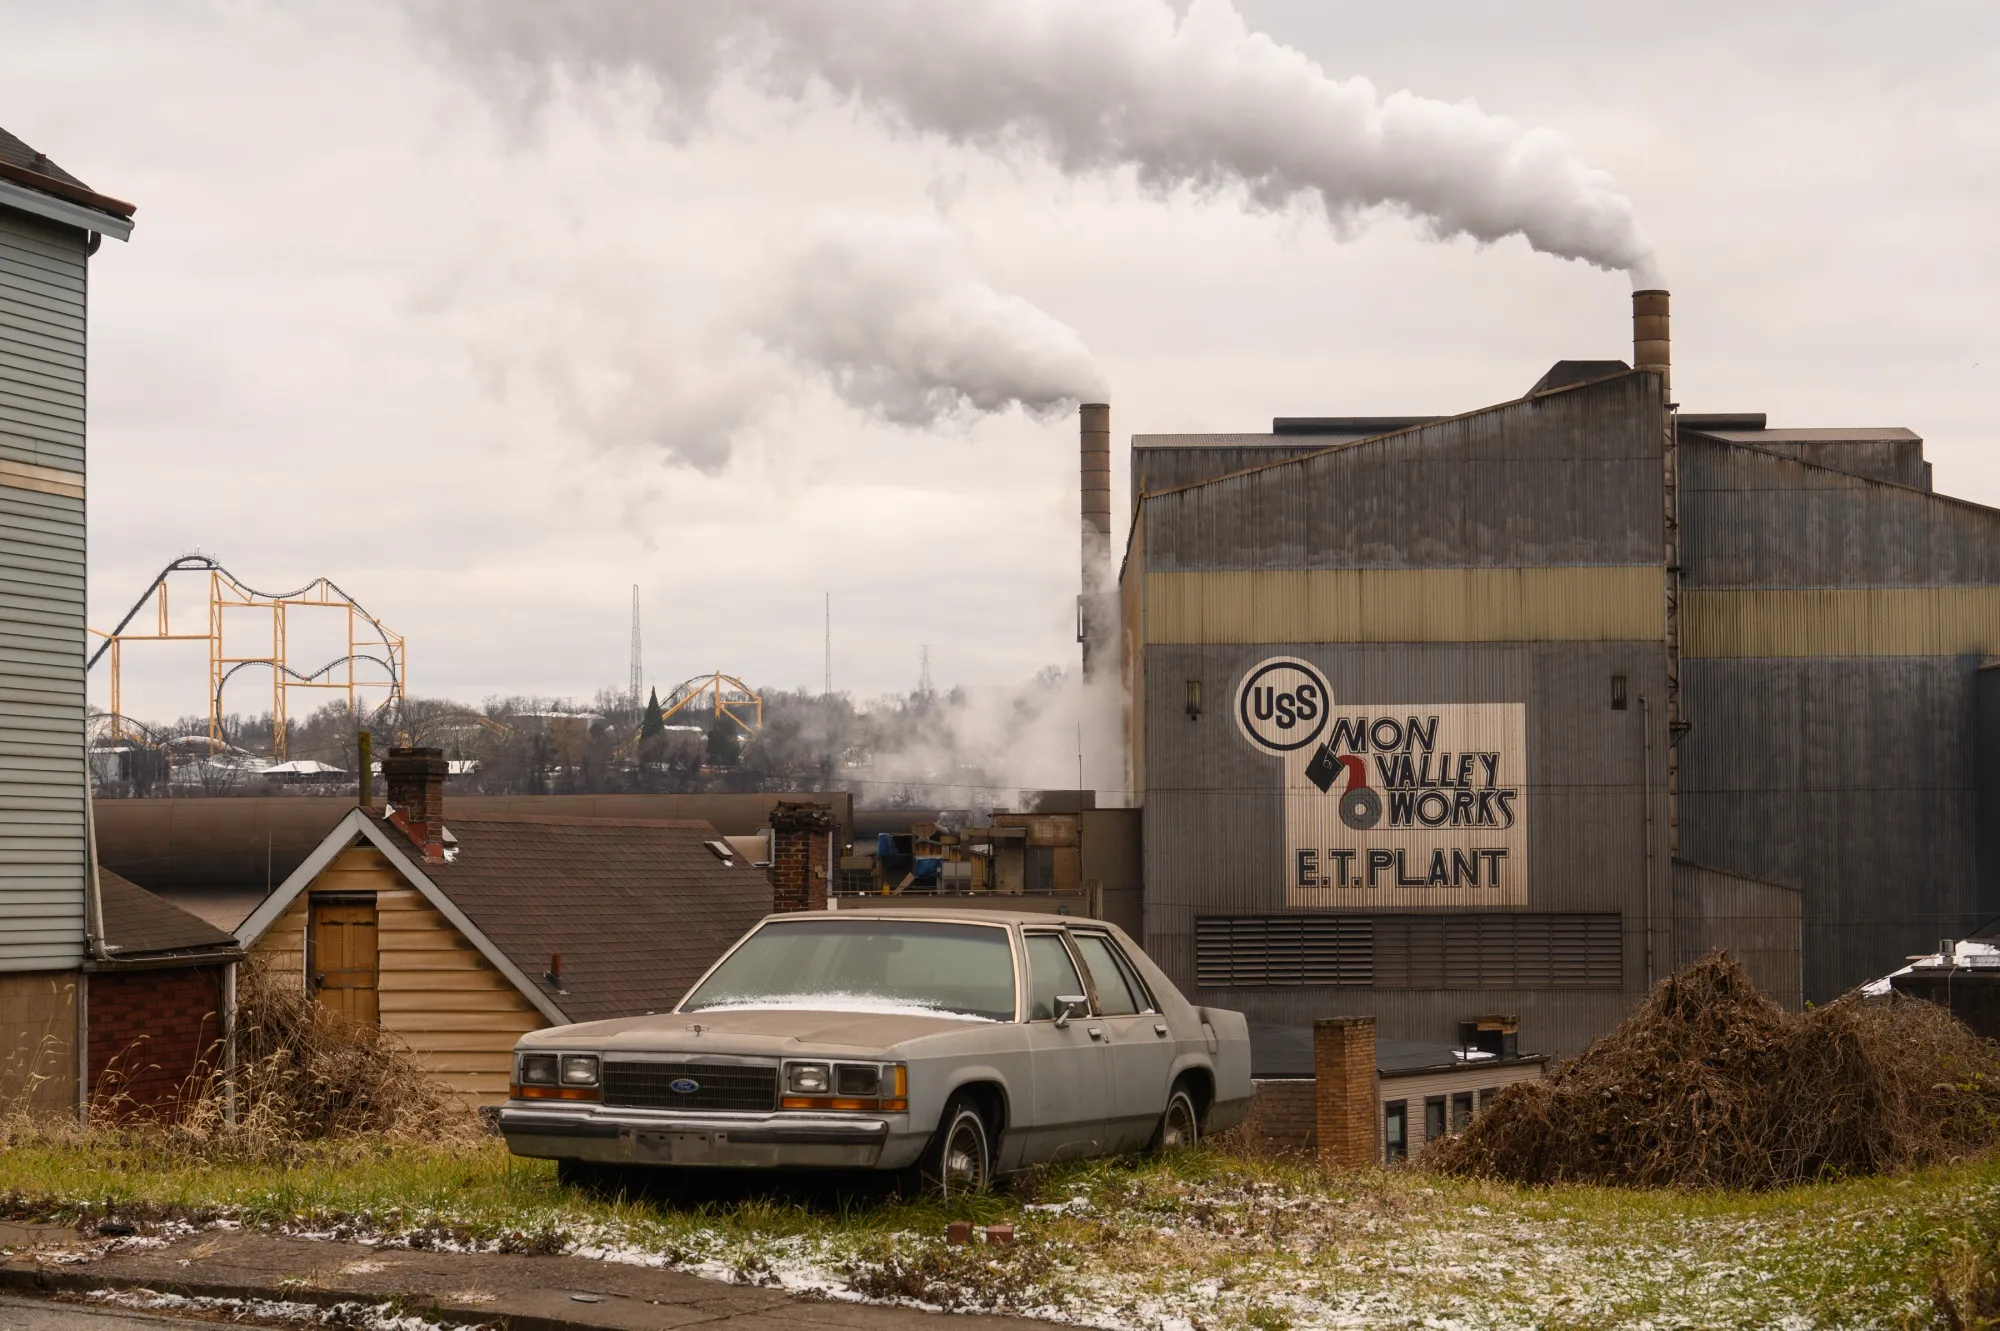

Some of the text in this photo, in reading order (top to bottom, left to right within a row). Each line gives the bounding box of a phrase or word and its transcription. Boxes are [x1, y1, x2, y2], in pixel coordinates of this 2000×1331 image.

[1254, 684, 1318, 730] USS
[1326, 716, 1440, 755] MON
[1373, 752, 1500, 790] VALLEY
[1387, 789, 1518, 829] WORKS
